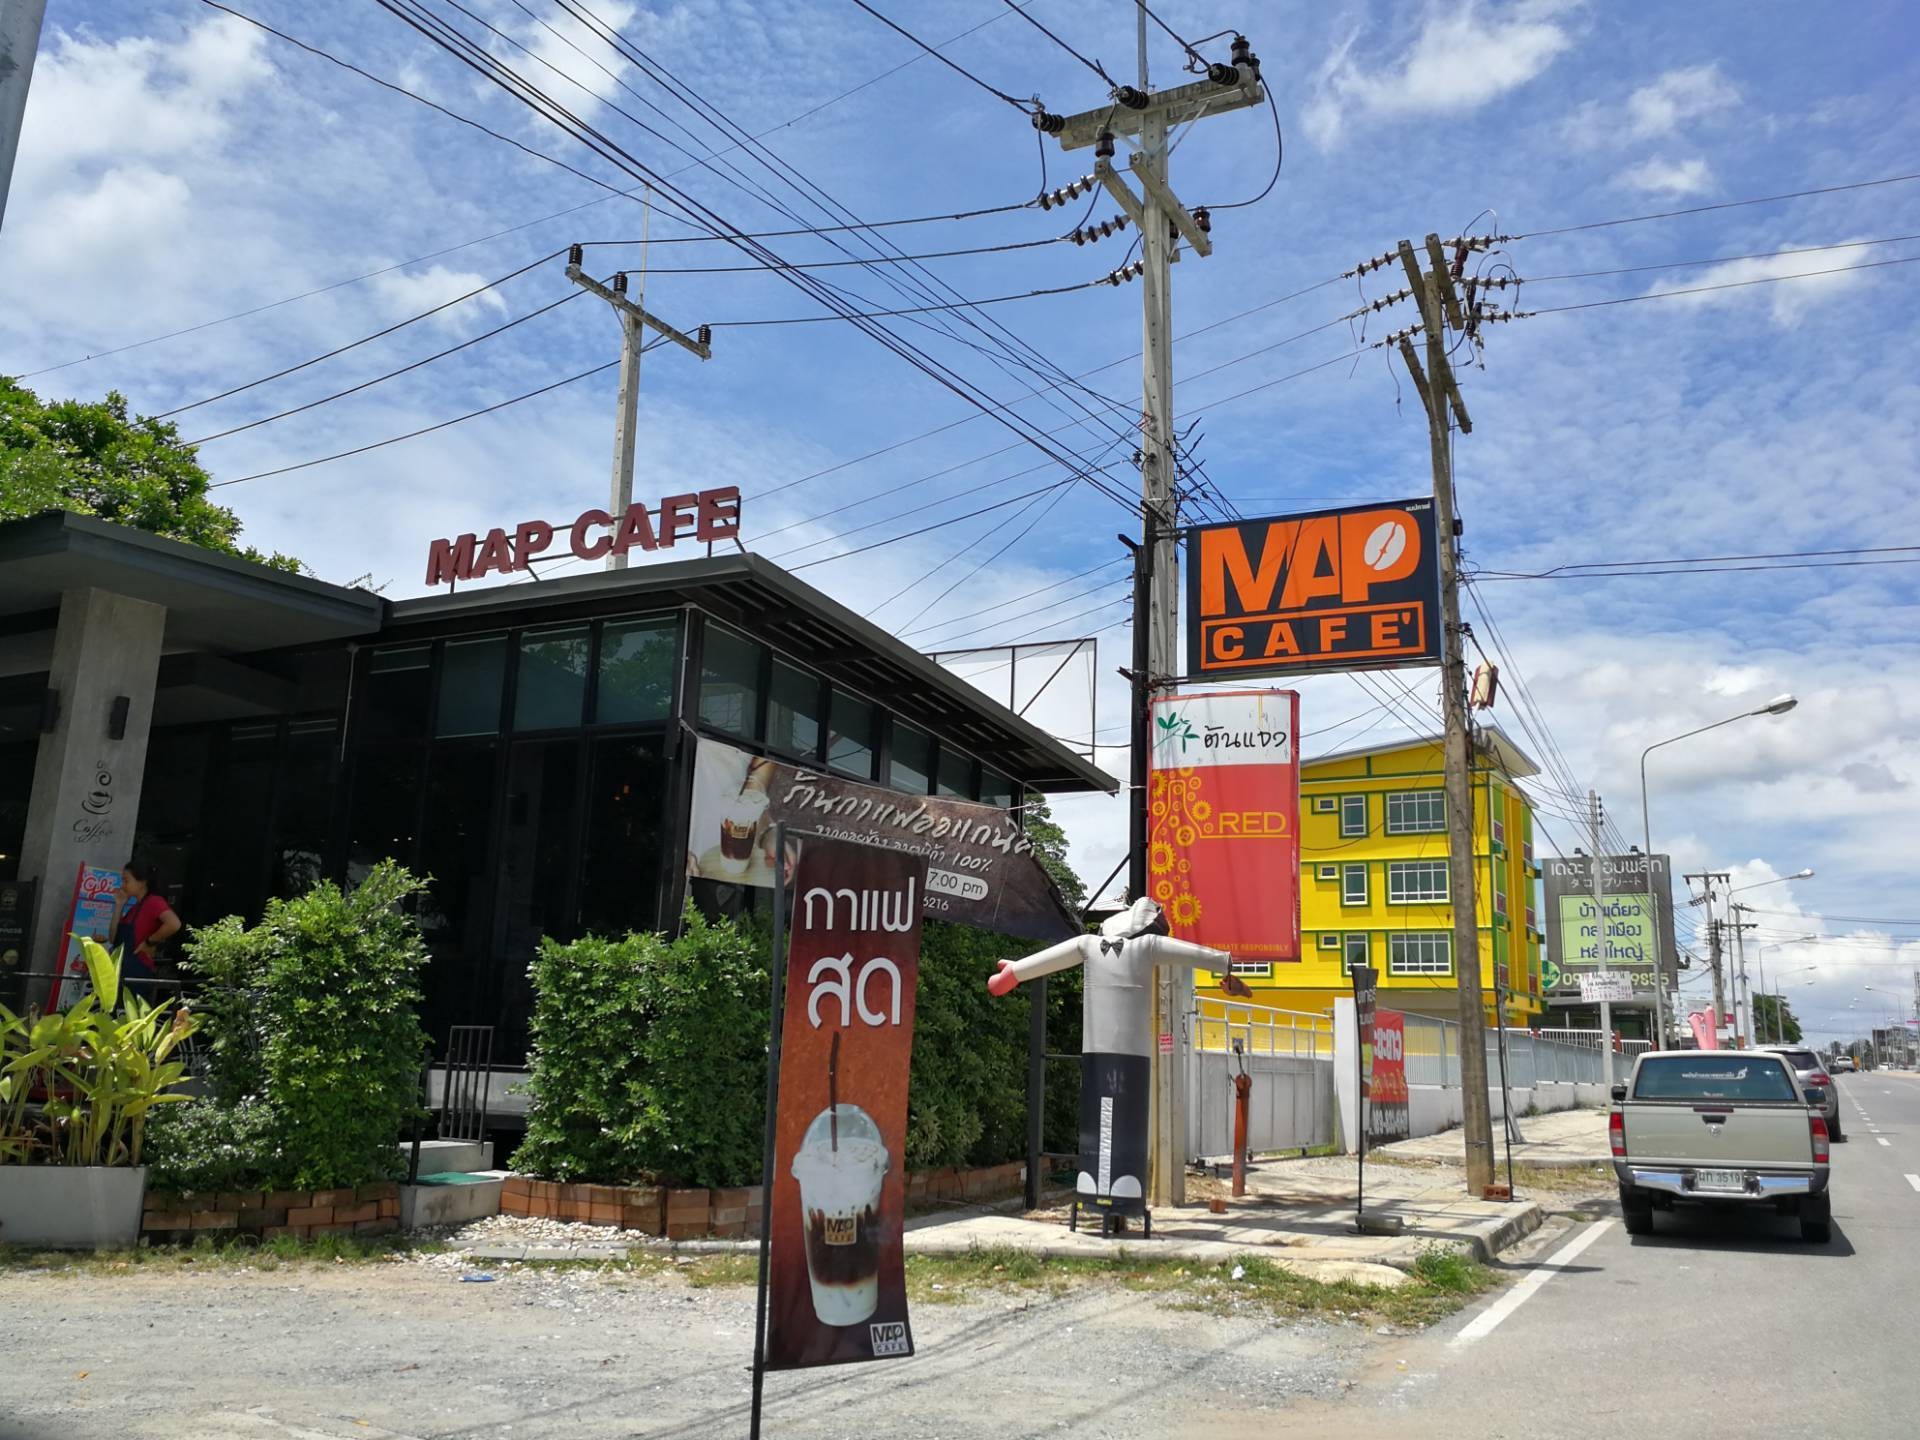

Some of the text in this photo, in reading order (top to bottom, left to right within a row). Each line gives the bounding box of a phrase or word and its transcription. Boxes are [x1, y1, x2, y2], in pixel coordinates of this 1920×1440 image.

[425, 486, 740, 586] MAP CAFE
[1200, 509, 1421, 616] MAP
[1219, 812, 1286, 834] RED
[952, 852, 993, 872] 100%
[961, 882, 983, 895] pm
[803, 877, 915, 932] กาแฟ
[1579, 898, 1641, 919] บ้าเดี่ยว
[1580, 922, 1642, 937] กลงเมือง
[807, 952, 901, 1029] สด
[826, 1218, 854, 1233] MAP
[871, 1325, 904, 1343] MAP
